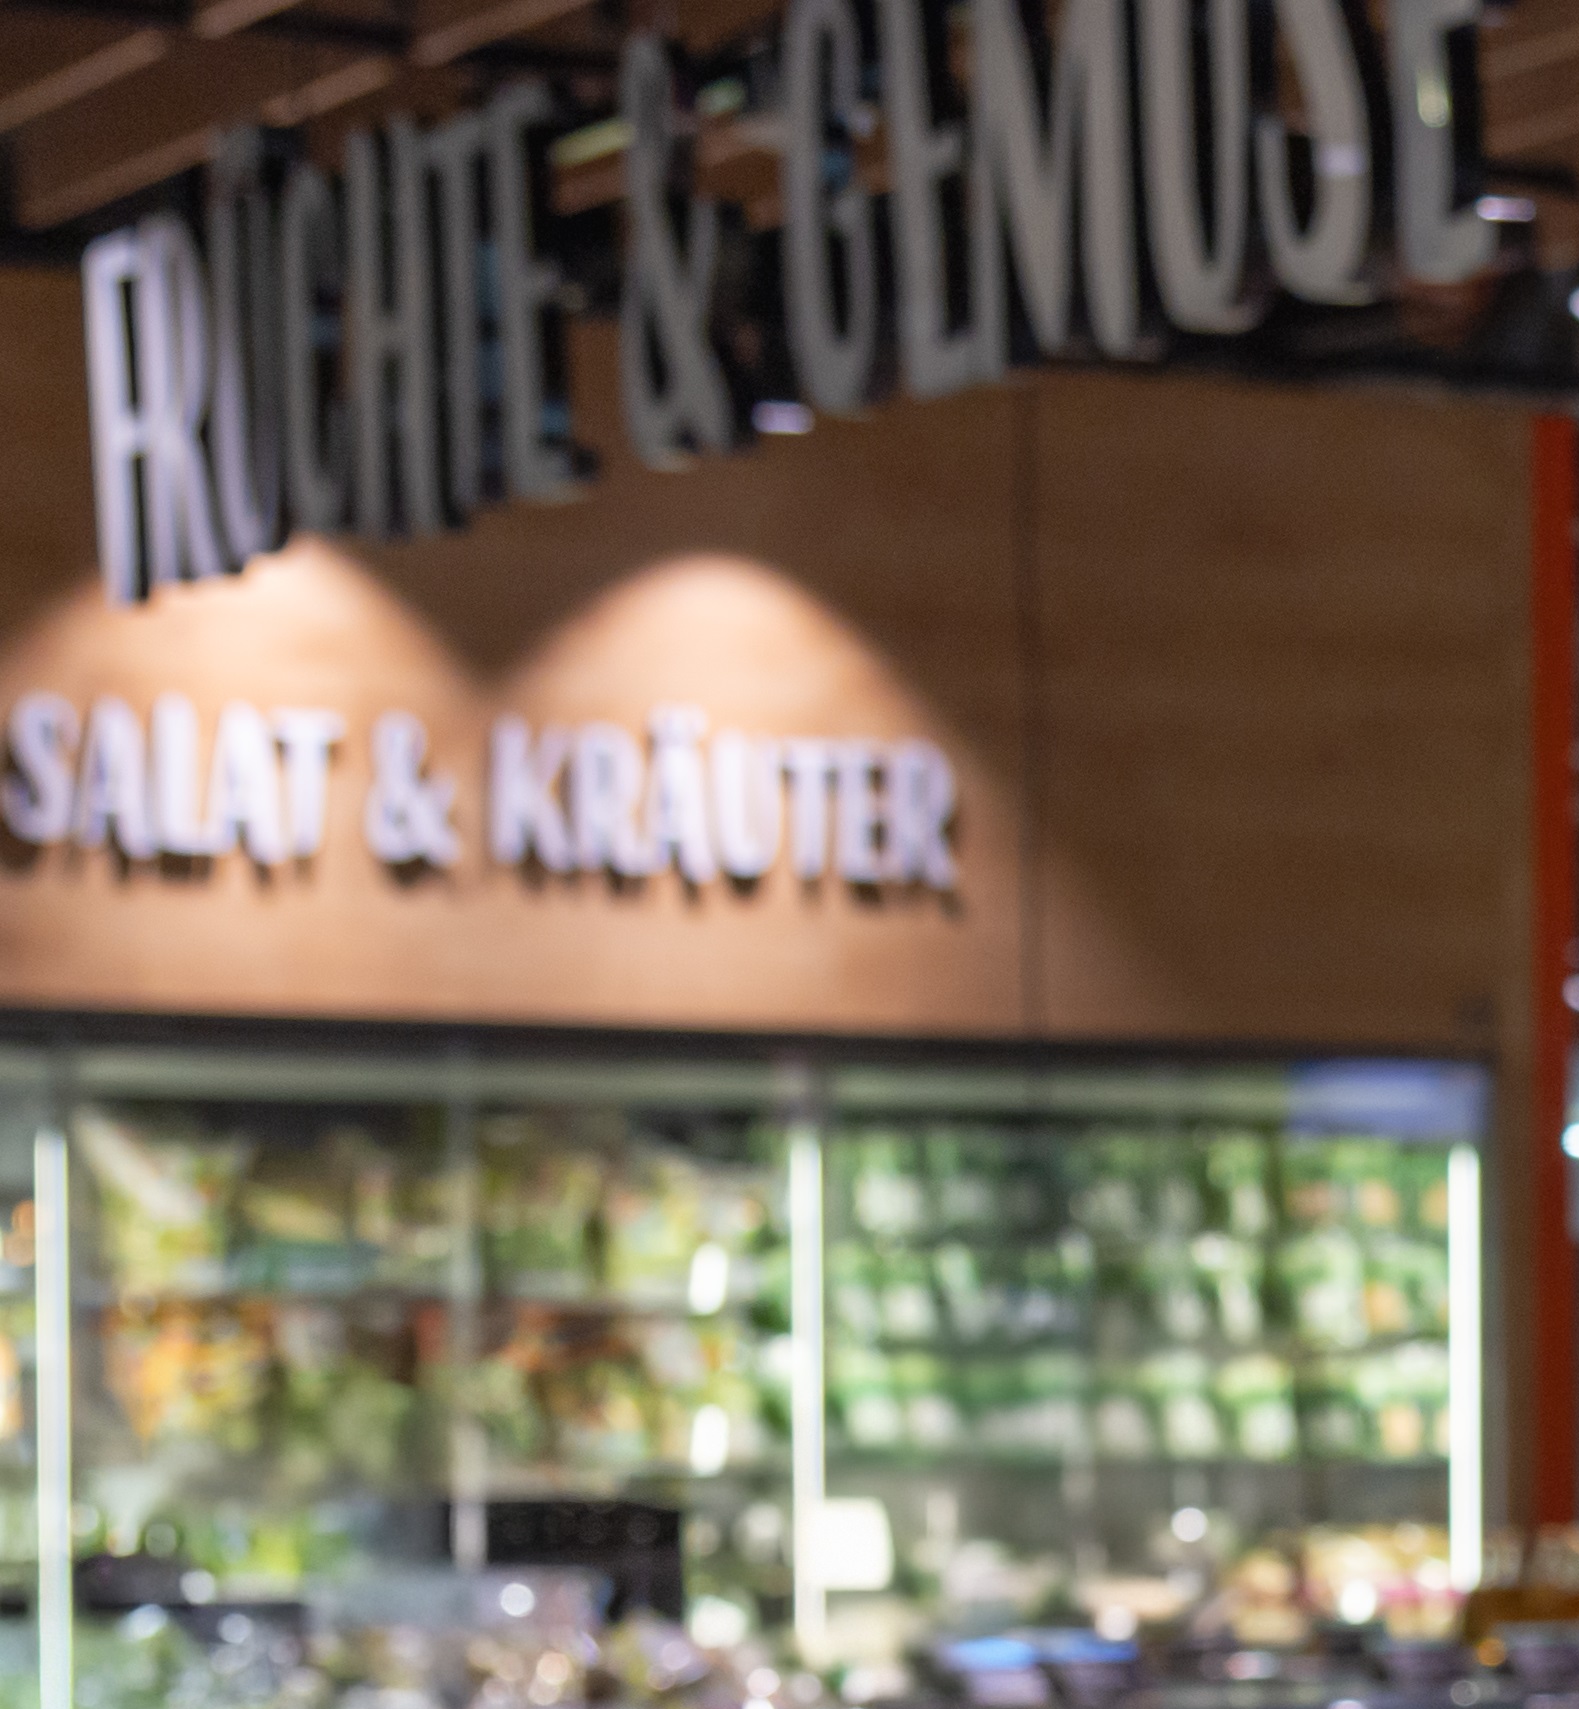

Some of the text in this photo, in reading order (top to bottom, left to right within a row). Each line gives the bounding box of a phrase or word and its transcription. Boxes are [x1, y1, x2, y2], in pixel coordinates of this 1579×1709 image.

[618, 30, 742, 472] &
[2, 690, 962, 892] SALAT & KRÄUTER
